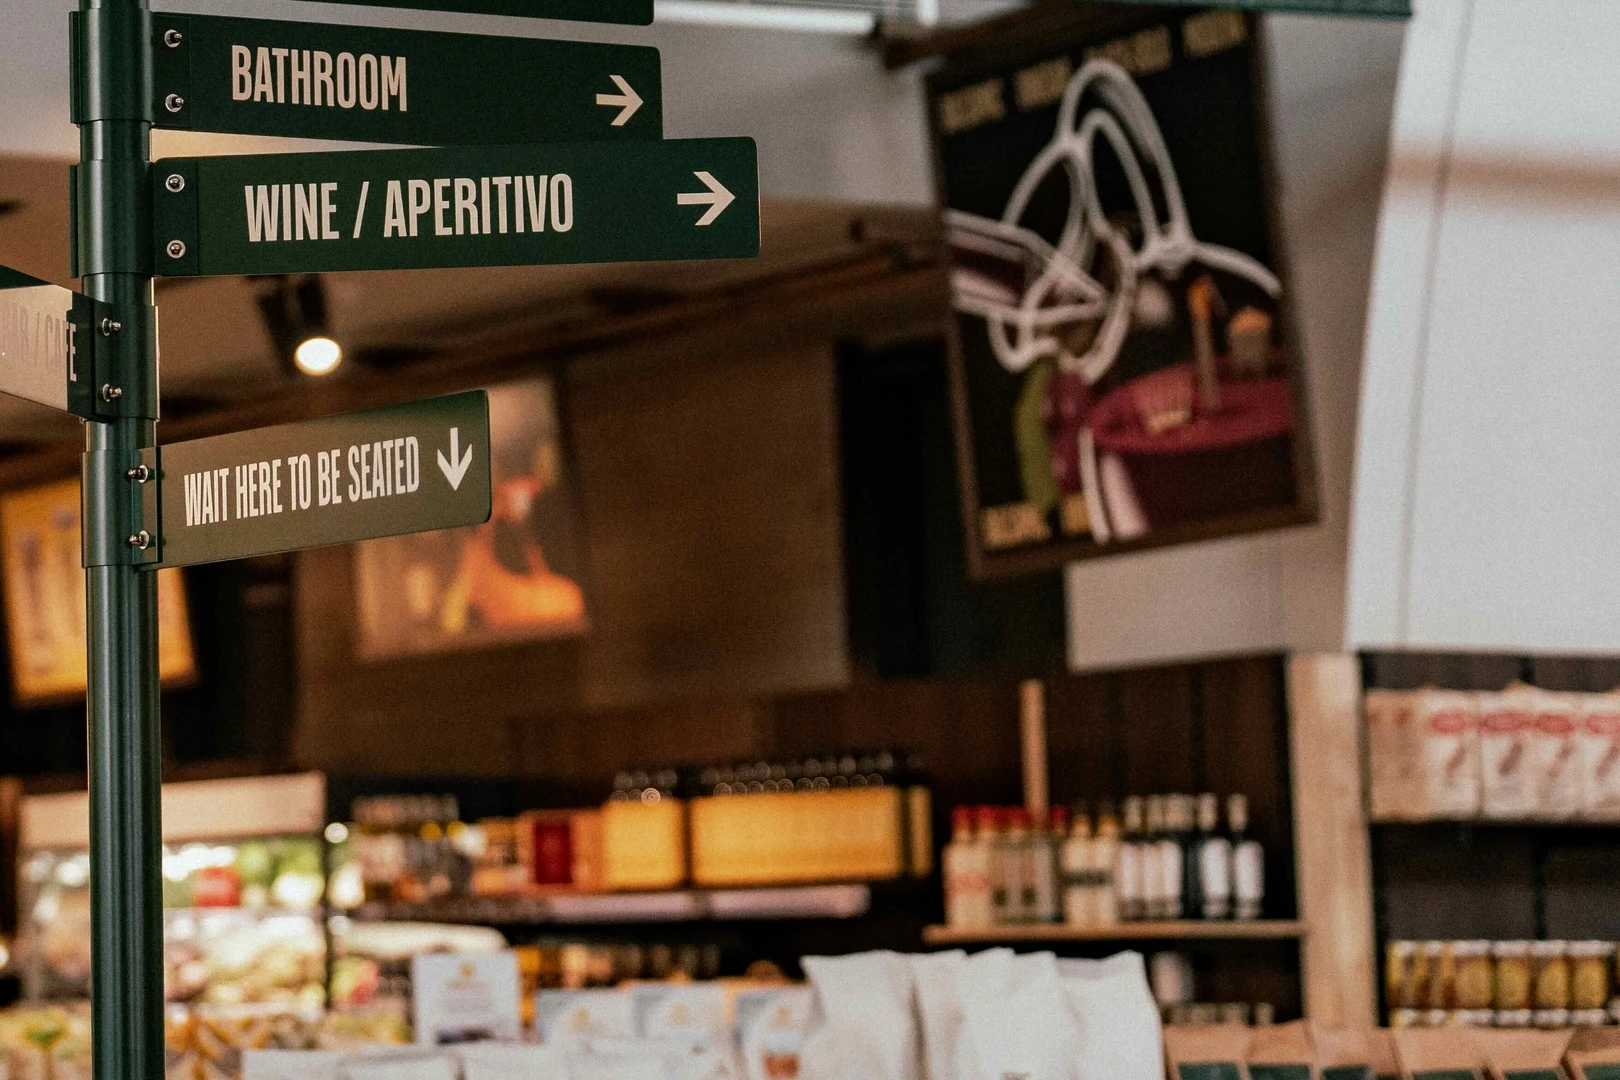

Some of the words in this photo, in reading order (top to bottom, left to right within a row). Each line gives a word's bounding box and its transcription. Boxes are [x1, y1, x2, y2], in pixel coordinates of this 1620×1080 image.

[232, 44, 408, 112] BATHROOM
[245, 182, 339, 242] WINE
[353, 181, 369, 239] /
[383, 173, 573, 238] APERITIVO
[183, 467, 230, 527] WAIT
[235, 458, 283, 519] HERE
[288, 453, 311, 511] TO
[318, 448, 342, 507] BE
[347, 436, 420, 502] SEATED
